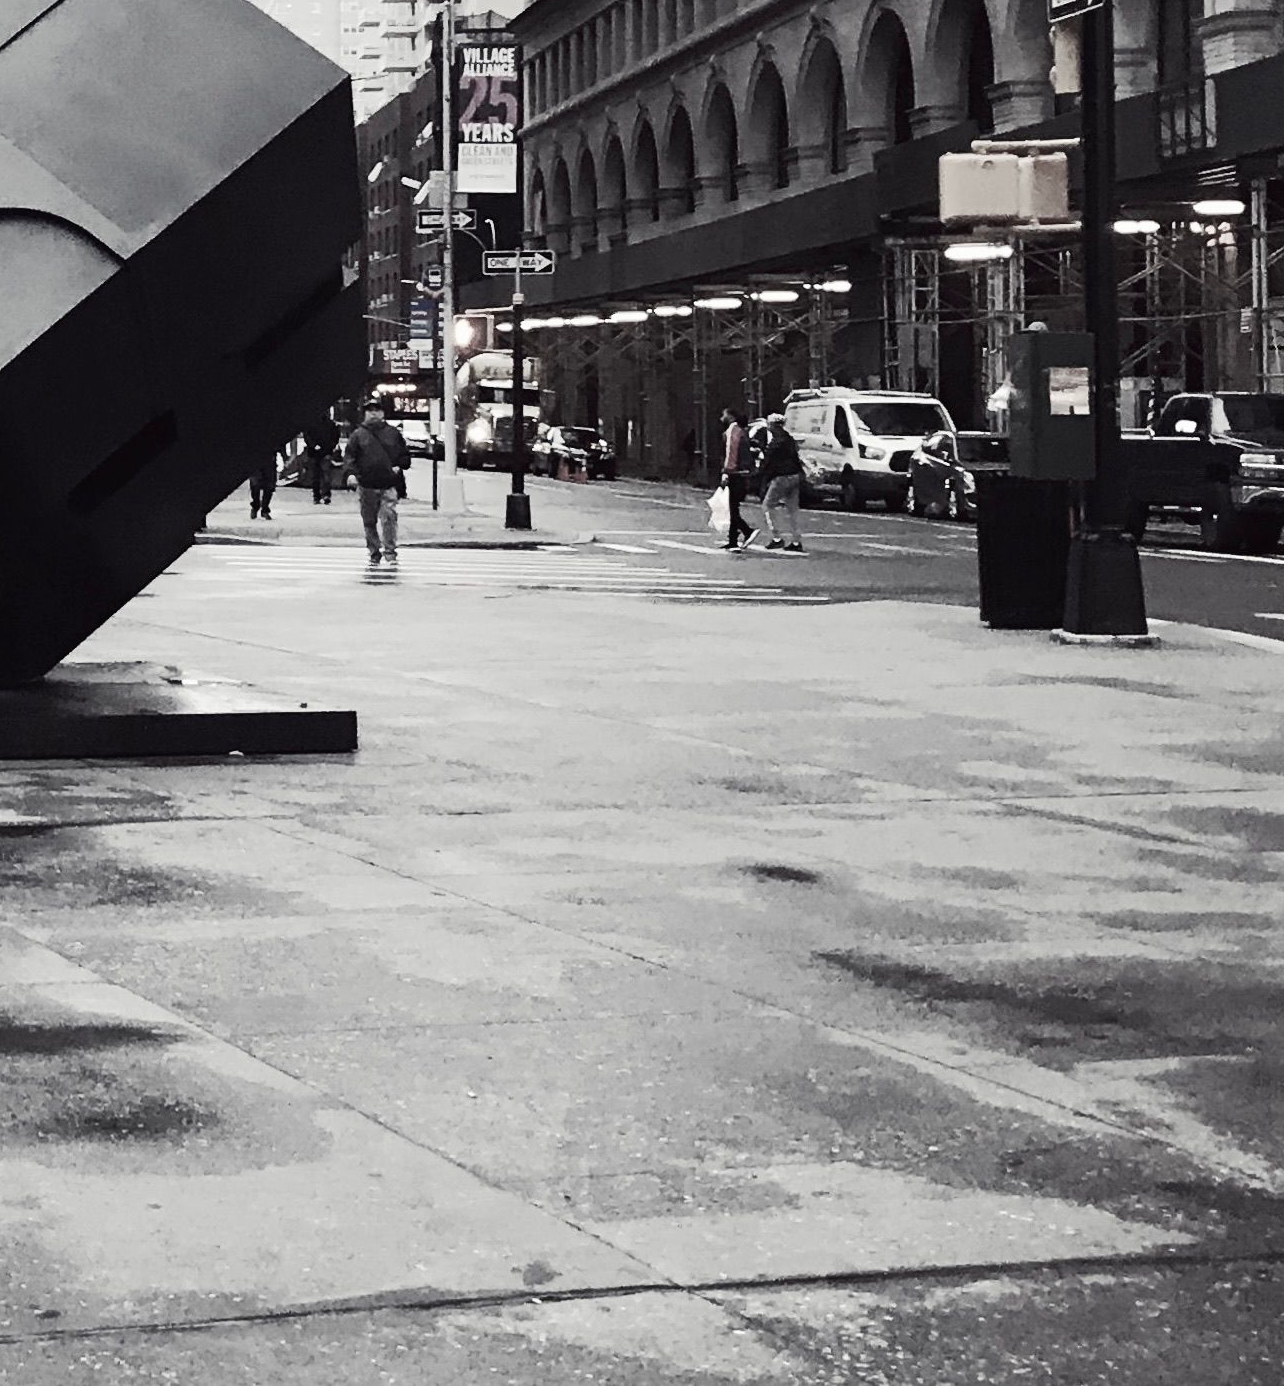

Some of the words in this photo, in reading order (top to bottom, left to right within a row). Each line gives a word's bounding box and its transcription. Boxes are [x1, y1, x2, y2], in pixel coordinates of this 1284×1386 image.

[463, 47, 515, 63] VILLAGE
[463, 63, 515, 76] ALLIANCE
[459, 76, 517, 128] 25
[462, 123, 514, 142] YEARS
[490, 258, 509, 266] ONE
